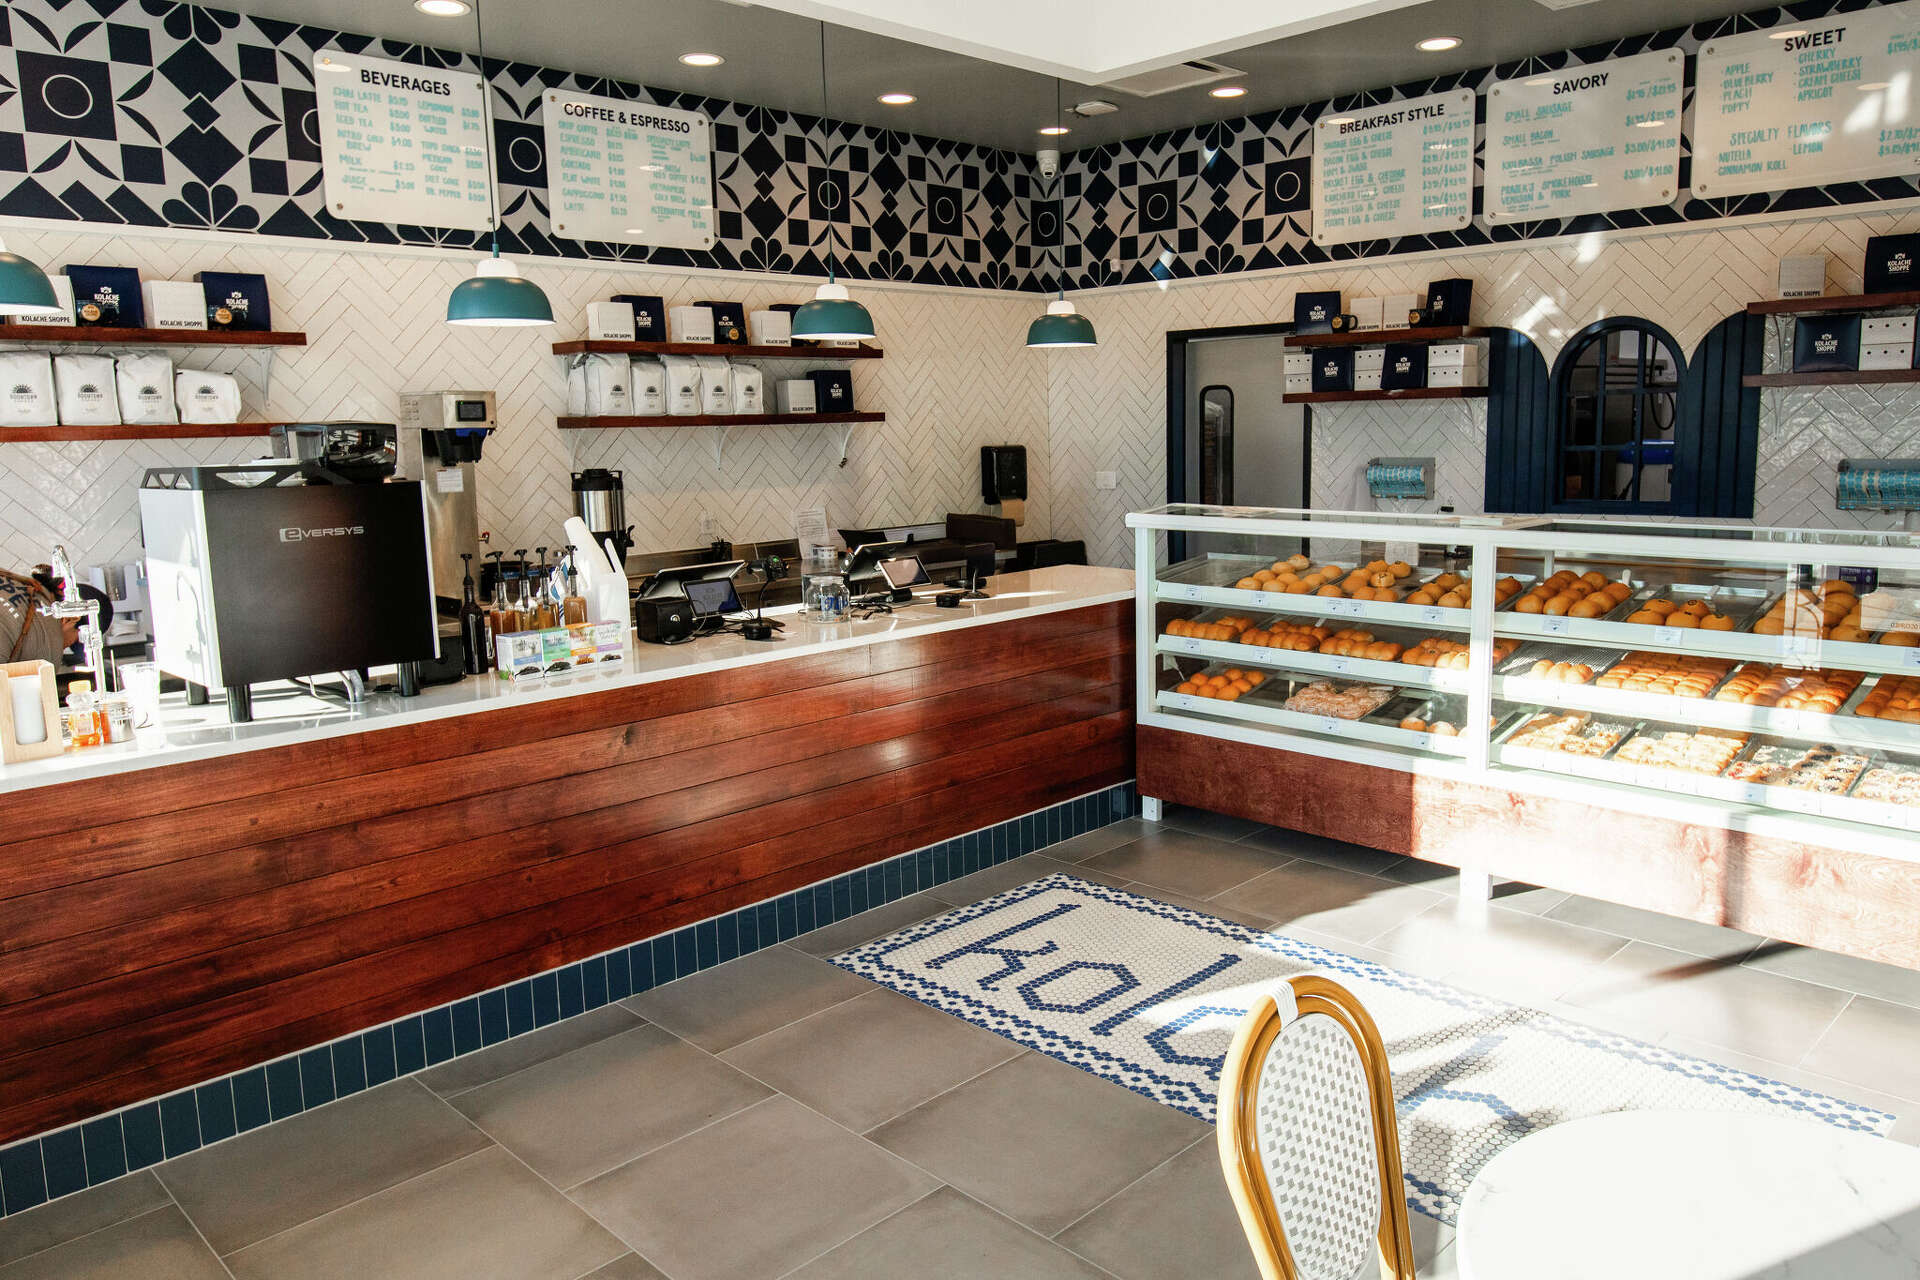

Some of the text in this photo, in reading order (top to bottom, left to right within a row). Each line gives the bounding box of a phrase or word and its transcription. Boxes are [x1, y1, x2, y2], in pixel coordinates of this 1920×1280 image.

[1784, 28, 1846, 52] SWEET
[1798, 48, 1836, 63] CHERRY
[1725, 62, 1751, 76] APPLE
[361, 69, 450, 96] BEVERAGES
[1553, 72, 1609, 95] SAVORY
[1798, 86, 1833, 102] APRICOT
[354, 103, 368, 114] TEA
[358, 118, 374, 128] TEA
[564, 103, 615, 122] COFFEE
[618, 112, 626, 124] &
[631, 114, 690, 134] ESPRESSO
[1340, 104, 1445, 134] BREAKFAST STYLE
[1887, 258, 1912, 267] KOLACHE
[1888, 264, 1910, 272] SHOPPE
[226, 298, 248, 306] KOLACHE
[48, 316, 72, 324] SHOPPE
[1816, 345, 1836, 353] SHOPPE
